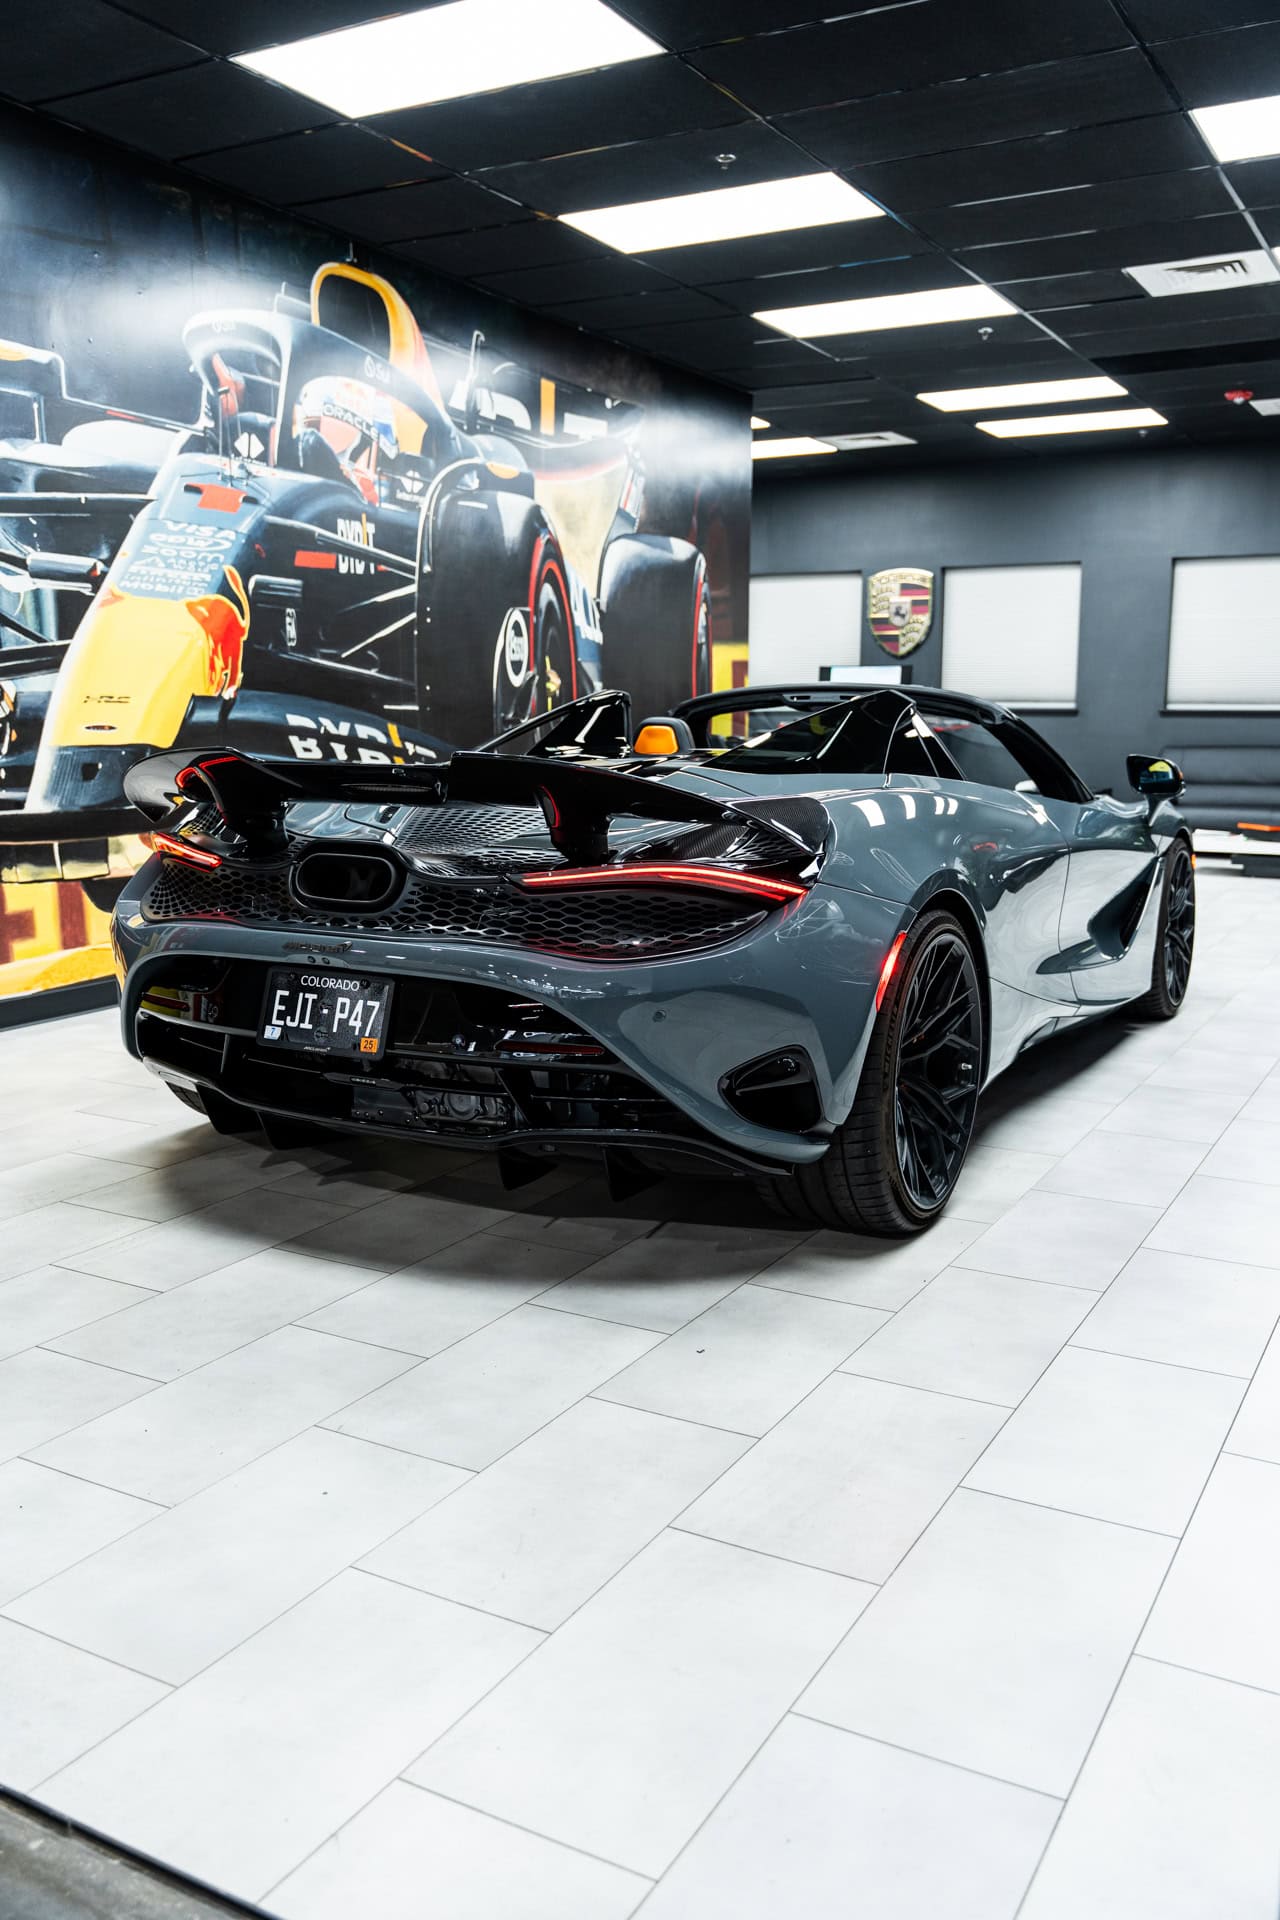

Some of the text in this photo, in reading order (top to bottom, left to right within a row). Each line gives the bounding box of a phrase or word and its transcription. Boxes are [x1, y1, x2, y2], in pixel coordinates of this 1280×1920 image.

[161, 519, 237, 541] VISA
[300, 974, 361, 992] COLORADO
[363, 1039, 374, 1050] 25
